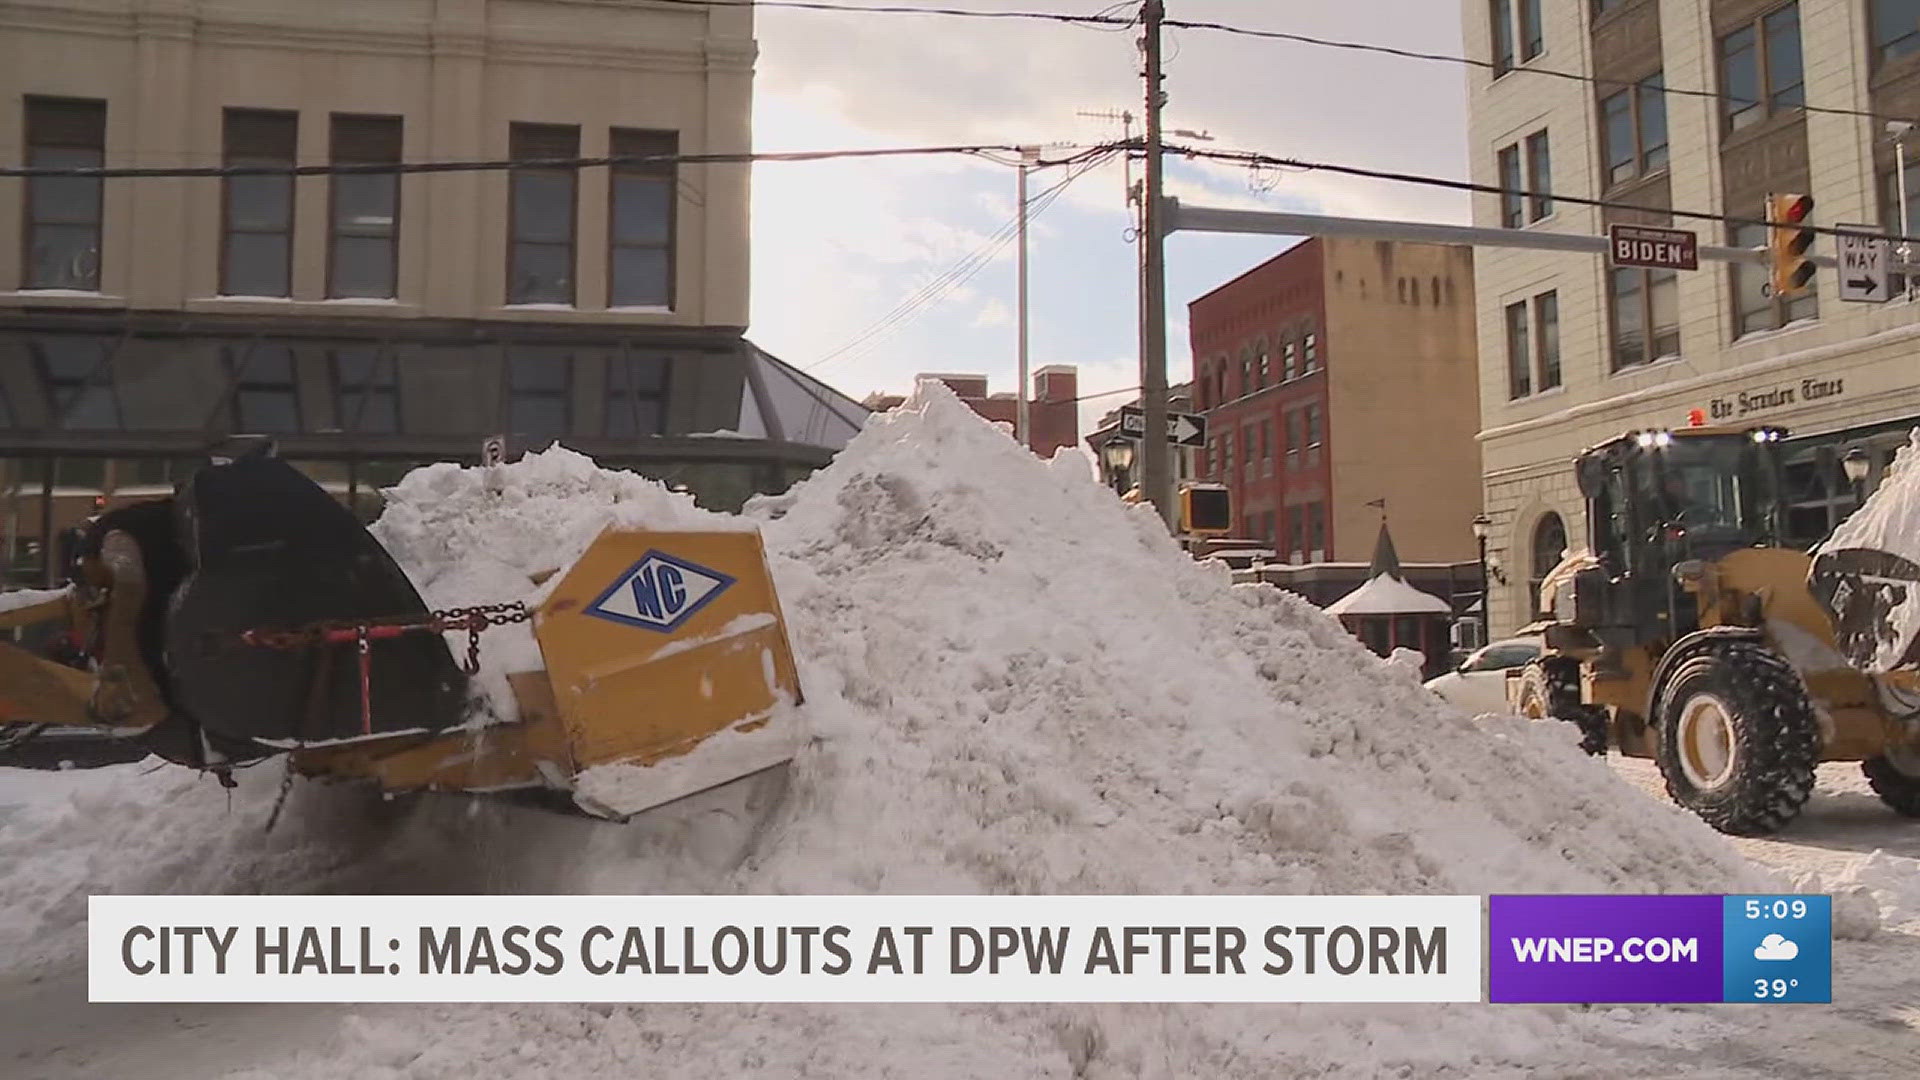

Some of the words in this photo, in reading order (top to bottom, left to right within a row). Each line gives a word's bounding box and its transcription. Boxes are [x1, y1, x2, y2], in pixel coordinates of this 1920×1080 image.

[1618, 239, 1681, 263] BIDEN
[1845, 252, 1877, 270] WAY
[1711, 399, 1732, 419] The
[1738, 386, 1795, 417] Scranton
[1801, 379, 1843, 400] Times
[631, 564, 687, 620] NC
